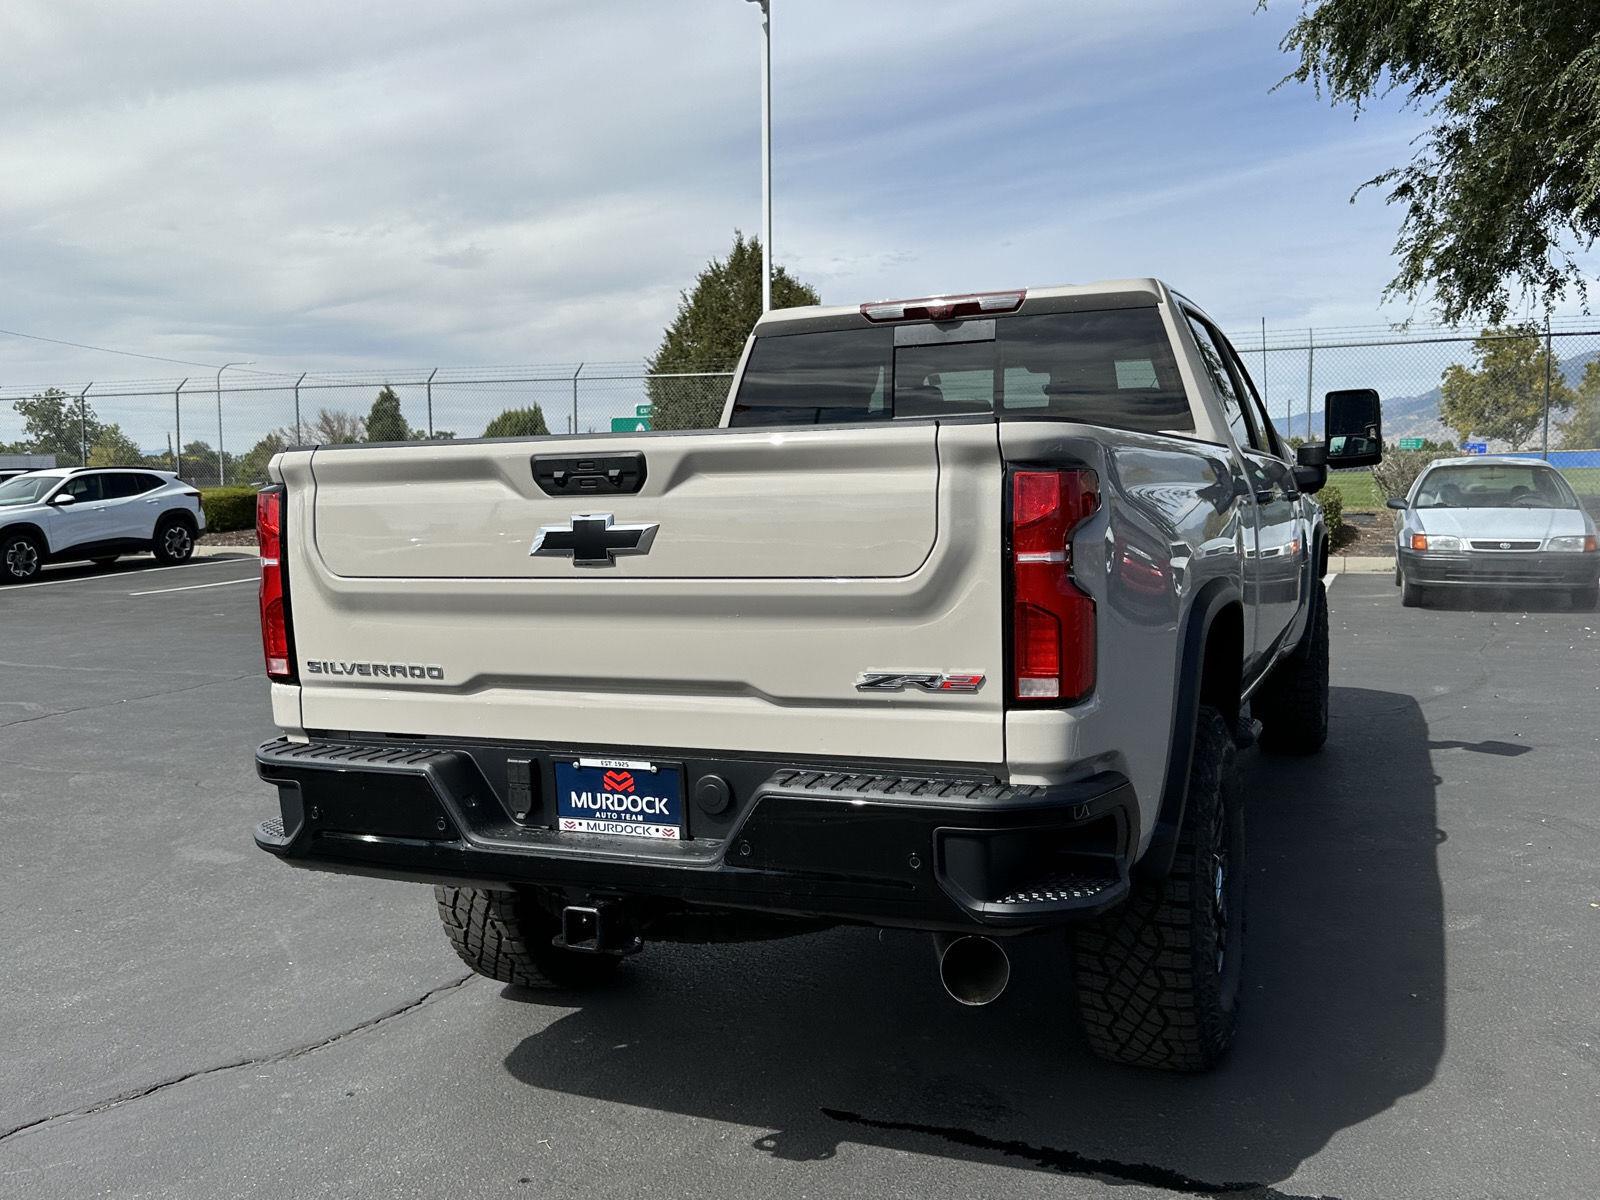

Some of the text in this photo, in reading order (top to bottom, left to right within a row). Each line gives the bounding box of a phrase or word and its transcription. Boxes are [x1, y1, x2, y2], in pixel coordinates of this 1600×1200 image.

[307, 661, 444, 680] SILVERADO
[855, 672, 986, 695] ZR2
[571, 791, 669, 815] MURDOCK
[595, 811, 643, 821] AUTO TEAM
[586, 823, 651, 836] MURDOCK
